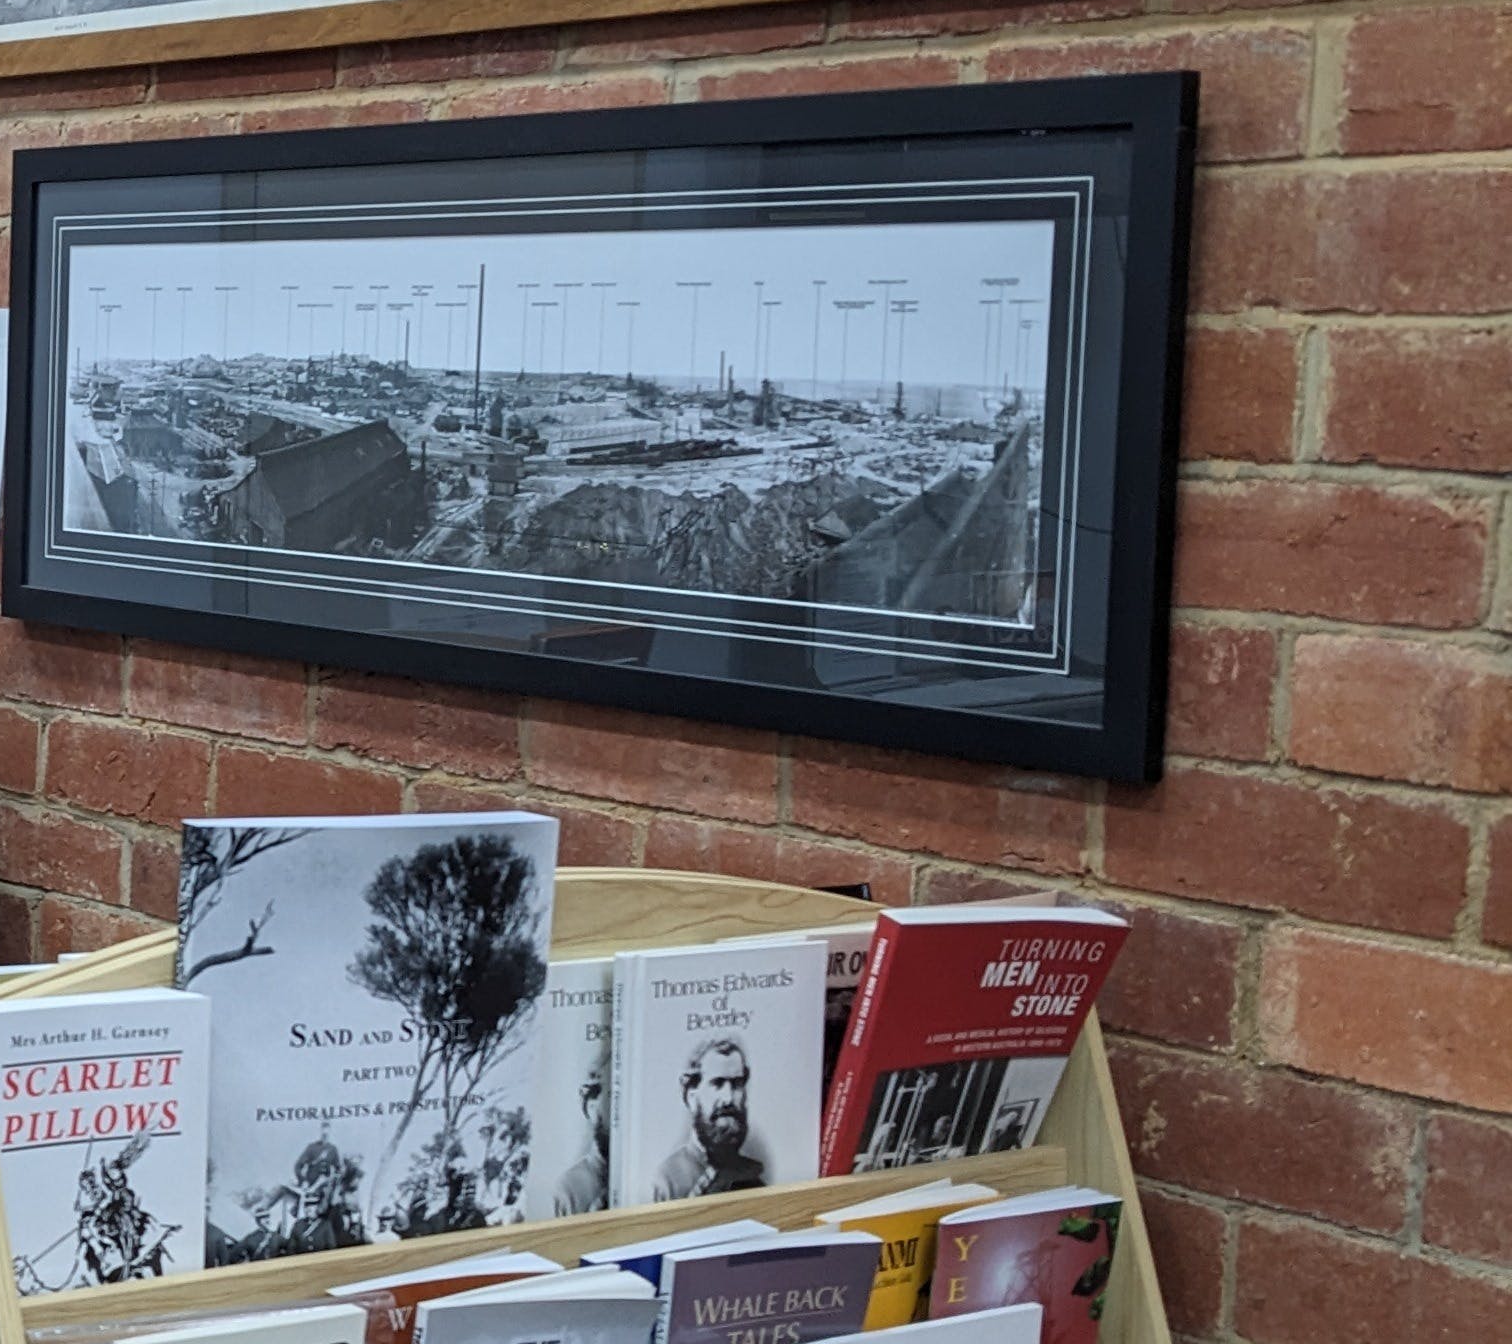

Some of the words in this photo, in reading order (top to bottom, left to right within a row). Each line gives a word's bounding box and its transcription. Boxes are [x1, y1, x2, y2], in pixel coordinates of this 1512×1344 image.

[1000, 939, 1105, 962] TURNING
[652, 977, 720, 999] Thomas
[723, 969, 794, 992] Edwards
[980, 961, 1040, 988] MEN
[1034, 974, 1088, 995] INTO
[712, 994, 728, 1012] of
[1010, 996, 1081, 1016] STONE
[687, 1010, 754, 1031] Beverley
[11, 1034, 35, 1048] Mrs
[40, 1030, 86, 1043] Arthur
[91, 1027, 106, 1040] H.
[112, 1026, 170, 1041] Garnsey
[290, 1023, 352, 1047] SAND
[360, 1029, 392, 1044] AND
[3, 1056, 181, 1100] SCARLET
[343, 1068, 381, 1082] PART
[384, 1065, 417, 1078] TWO
[2, 1100, 178, 1145] PILLOWS
[694, 1291, 780, 1326] WHALE
[784, 1286, 848, 1312] BACK
